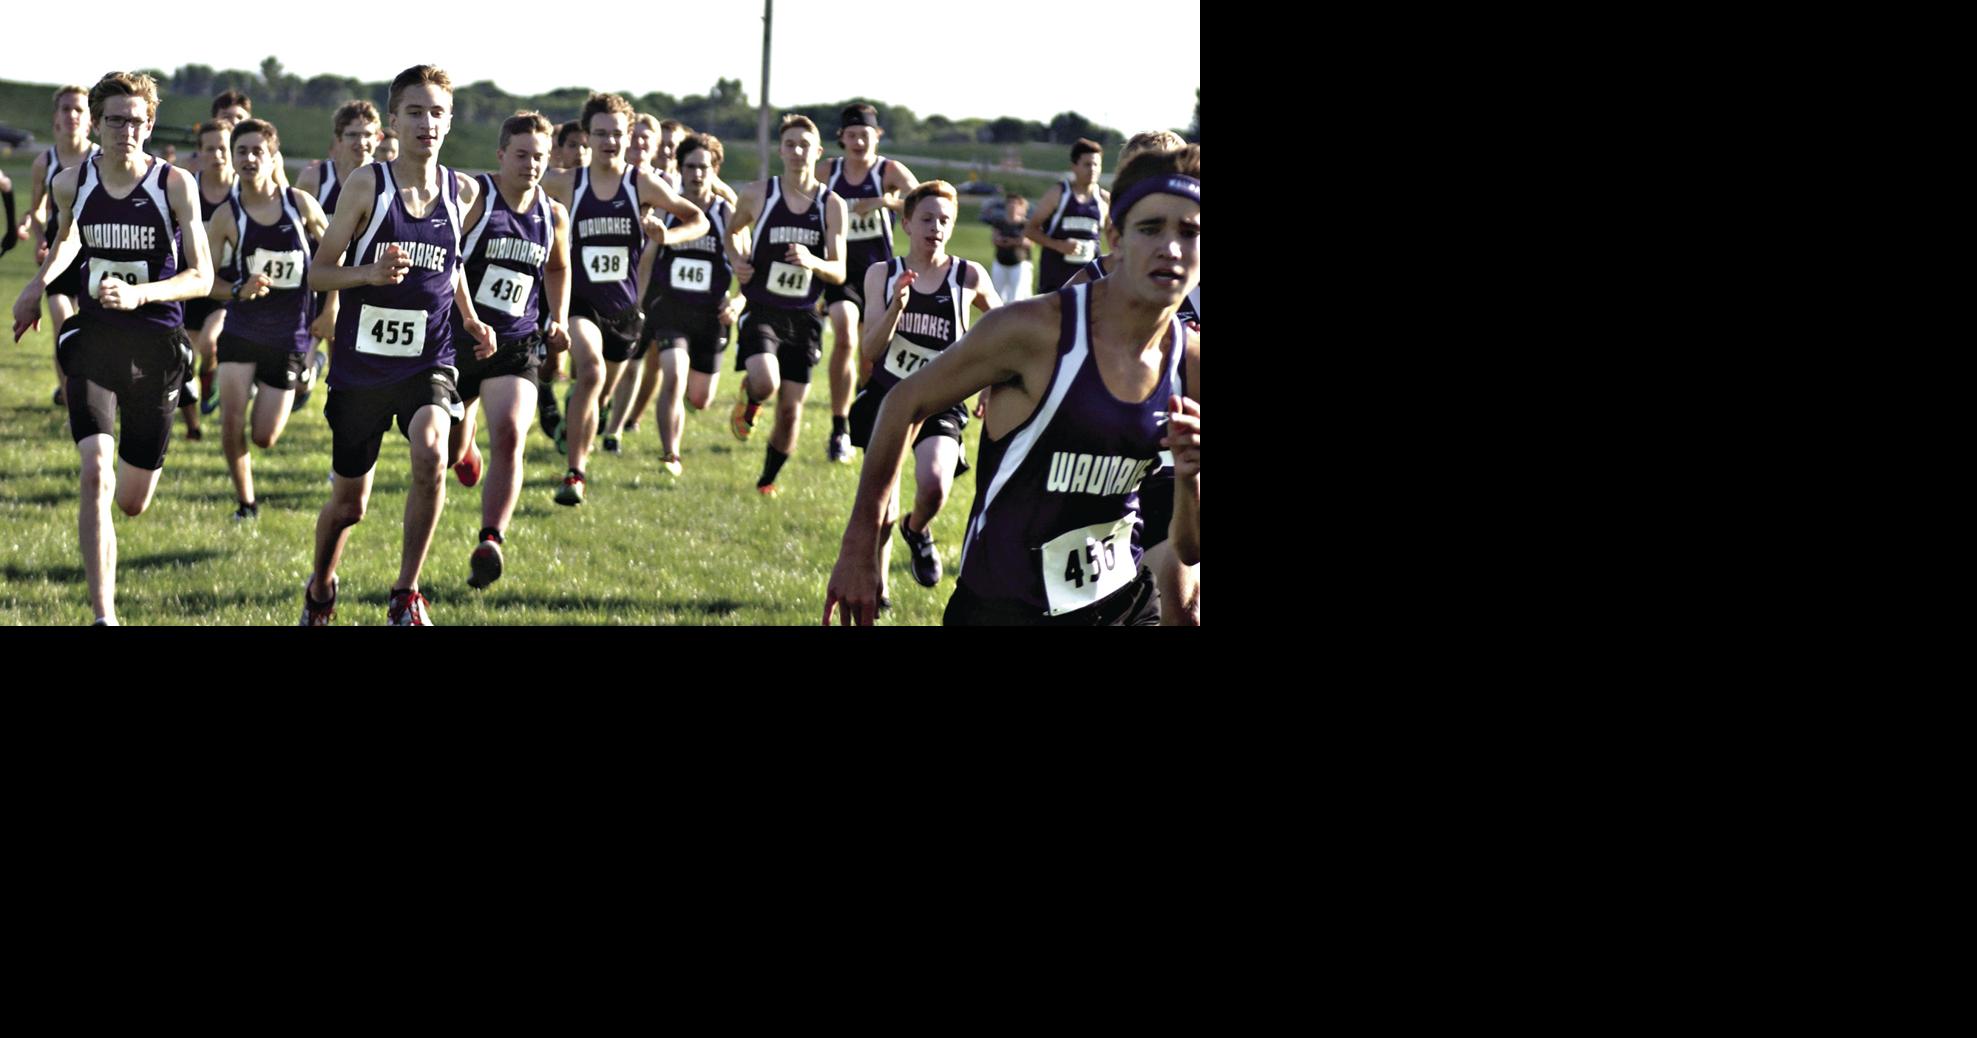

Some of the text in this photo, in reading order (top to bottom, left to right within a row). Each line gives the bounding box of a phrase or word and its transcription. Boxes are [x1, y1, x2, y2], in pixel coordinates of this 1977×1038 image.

[83, 223, 155, 250] WAUNAKEE
[578, 217, 631, 238] WAUNAKEE
[374, 241, 447, 273] WNAKEE
[591, 255, 620, 273] 438
[263, 260, 295, 280] 437
[678, 266, 704, 283] 446
[777, 272, 803, 289] 441
[490, 278, 523, 303] 430
[371, 319, 415, 346] 455
[898, 312, 950, 340] AUNAKEE
